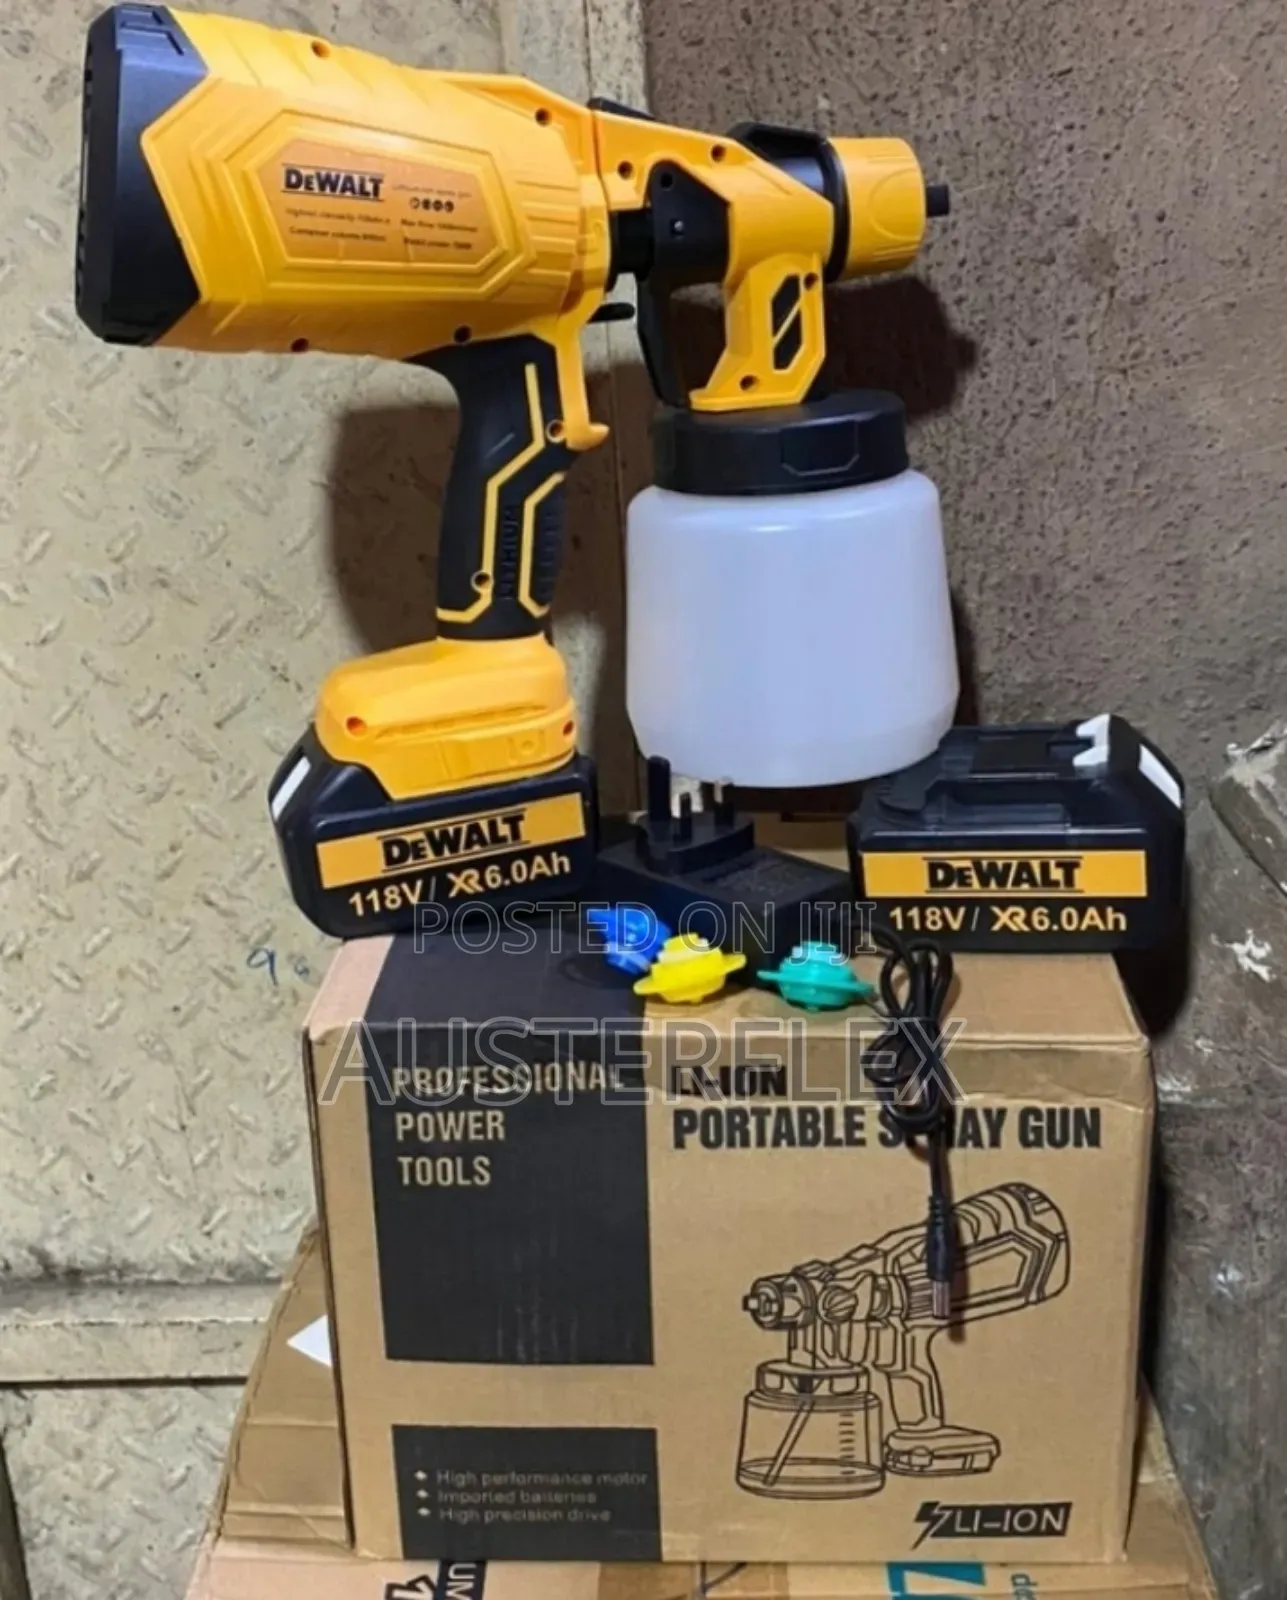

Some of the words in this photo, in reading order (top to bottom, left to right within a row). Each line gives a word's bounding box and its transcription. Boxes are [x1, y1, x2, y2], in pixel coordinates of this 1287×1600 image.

[393, 1062, 624, 1096] PROFESSIONAL
[395, 1110, 506, 1142] POWER
[673, 1107, 867, 1150] PORTABLE
[1018, 1107, 1103, 1149] GUN
[400, 1155, 493, 1188] TOOLS
[953, 1508, 1064, 1534] LI-ION
